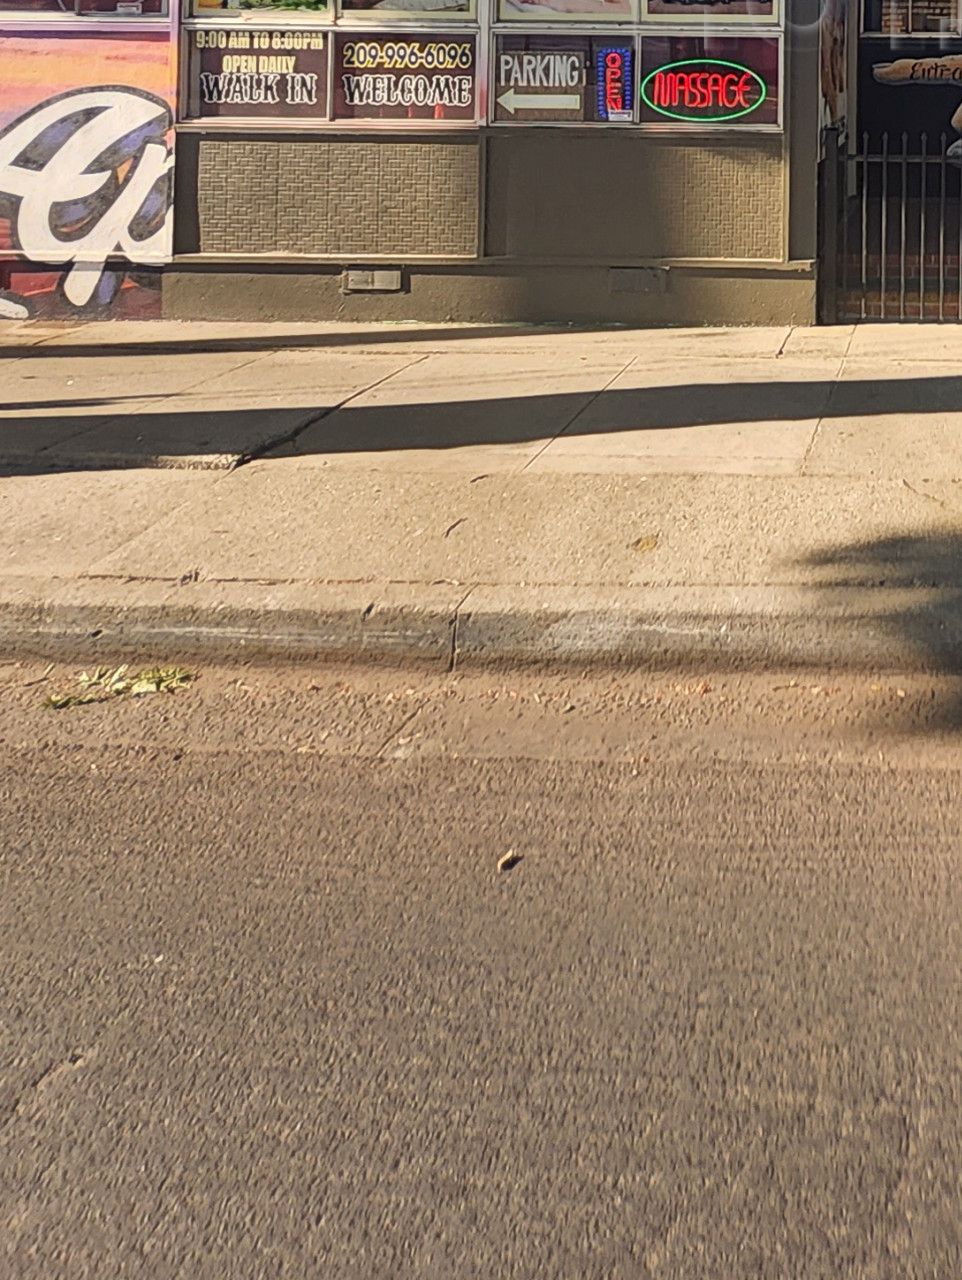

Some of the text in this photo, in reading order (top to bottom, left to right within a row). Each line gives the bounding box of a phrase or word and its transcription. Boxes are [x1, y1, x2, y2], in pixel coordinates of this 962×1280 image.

[196, 31, 227, 50] 9:00
[228, 31, 250, 50] AM
[250, 31, 270, 50] TO
[342, 42, 473, 70] 209-996-6096
[222, 55, 297, 74] OPEN DAILY
[500, 53, 581, 88] PARKING
[200, 72, 319, 105] WALK IN
[341, 74, 473, 107] WELCOME
[605, 52, 622, 111] OPEN
[653, 72, 752, 108] MASSAGE
